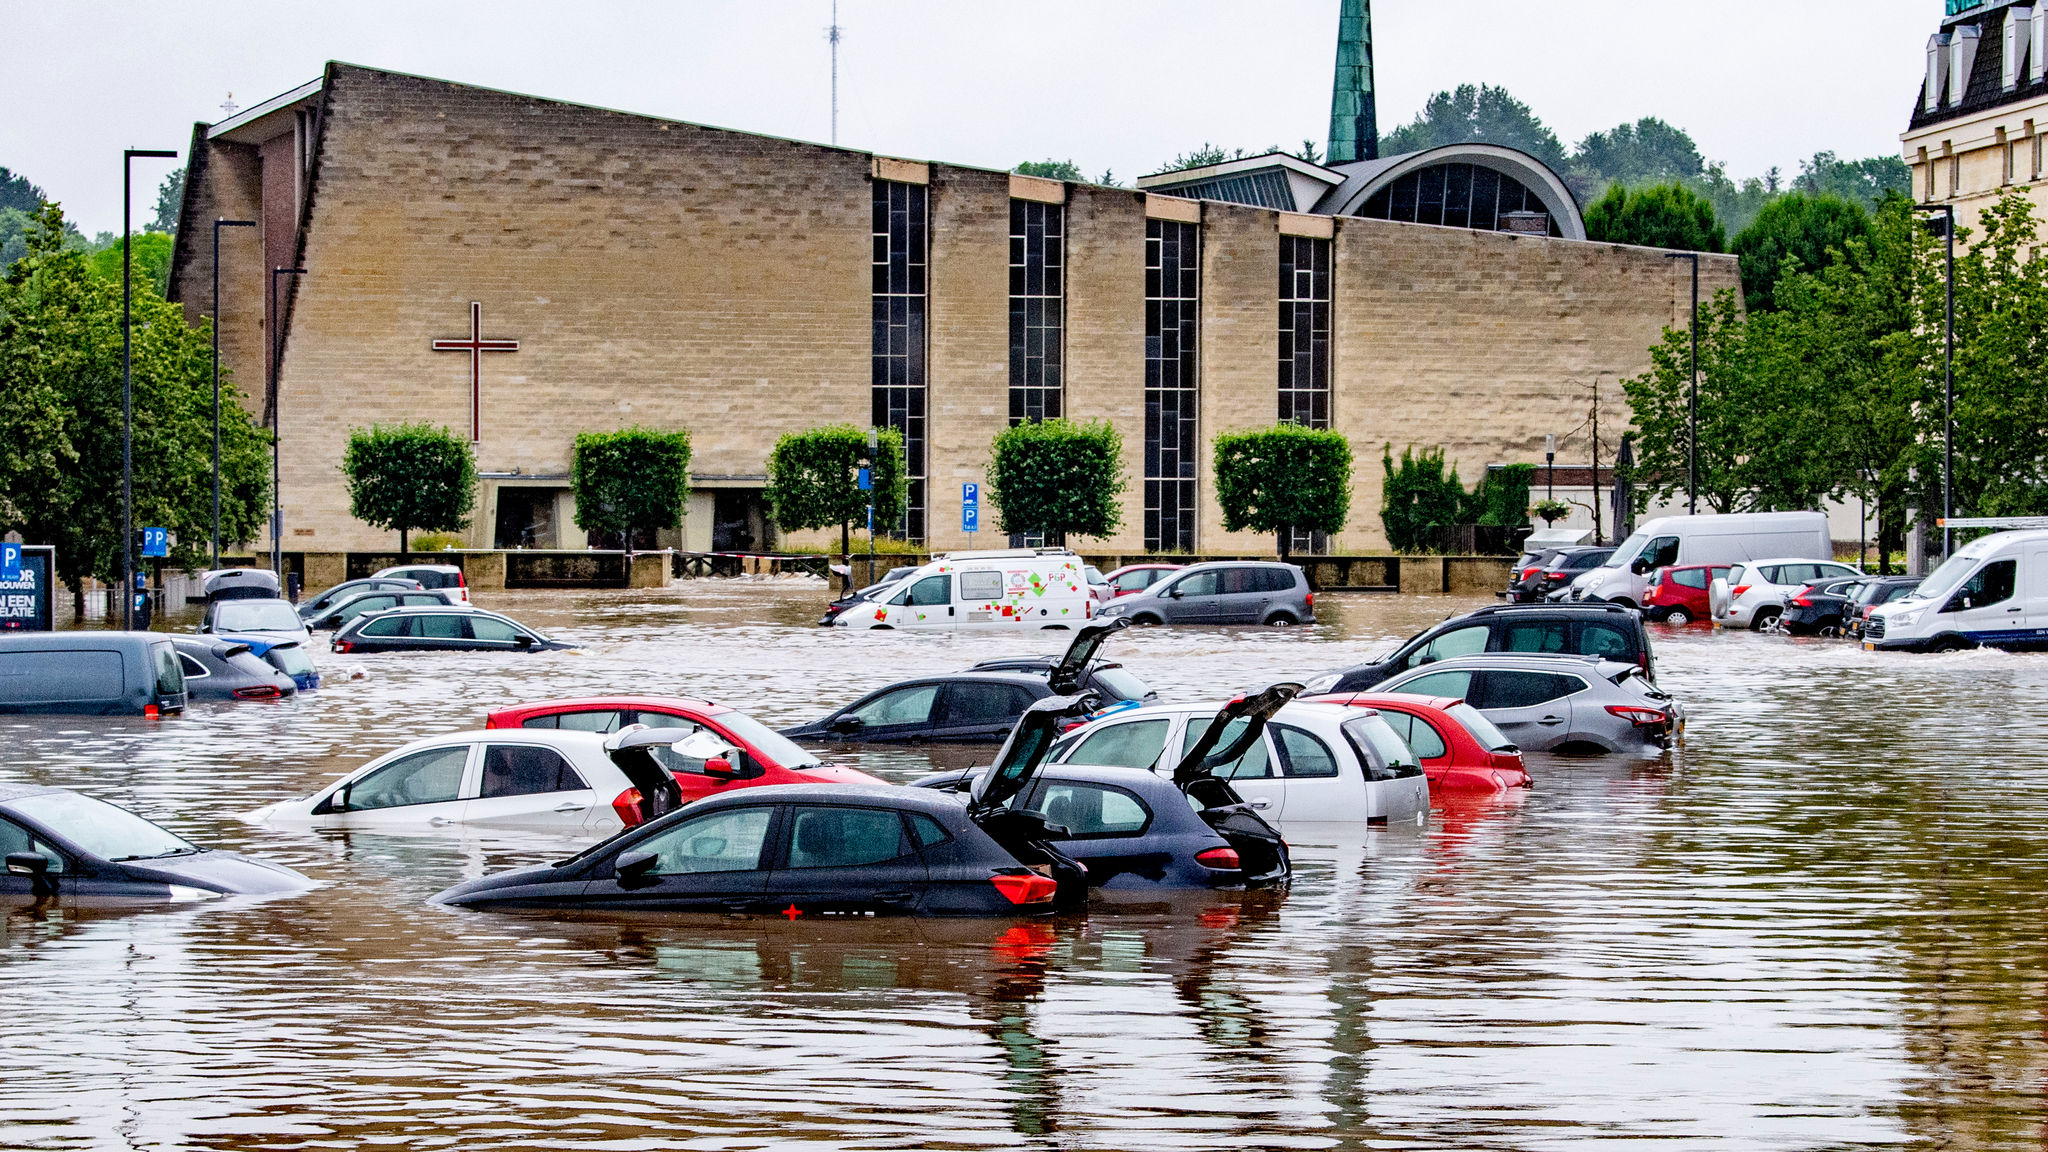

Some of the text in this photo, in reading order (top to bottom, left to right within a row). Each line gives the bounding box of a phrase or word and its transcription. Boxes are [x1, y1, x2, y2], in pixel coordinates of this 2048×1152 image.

[966, 485, 975, 497] P
[966, 510, 975, 522] P
[145, 531, 164, 546] P P
[5, 548, 16, 567] P
[7, 594, 35, 608] EEN
[135, 594, 143, 605] P
[0, 607, 35, 617] ELATIE
